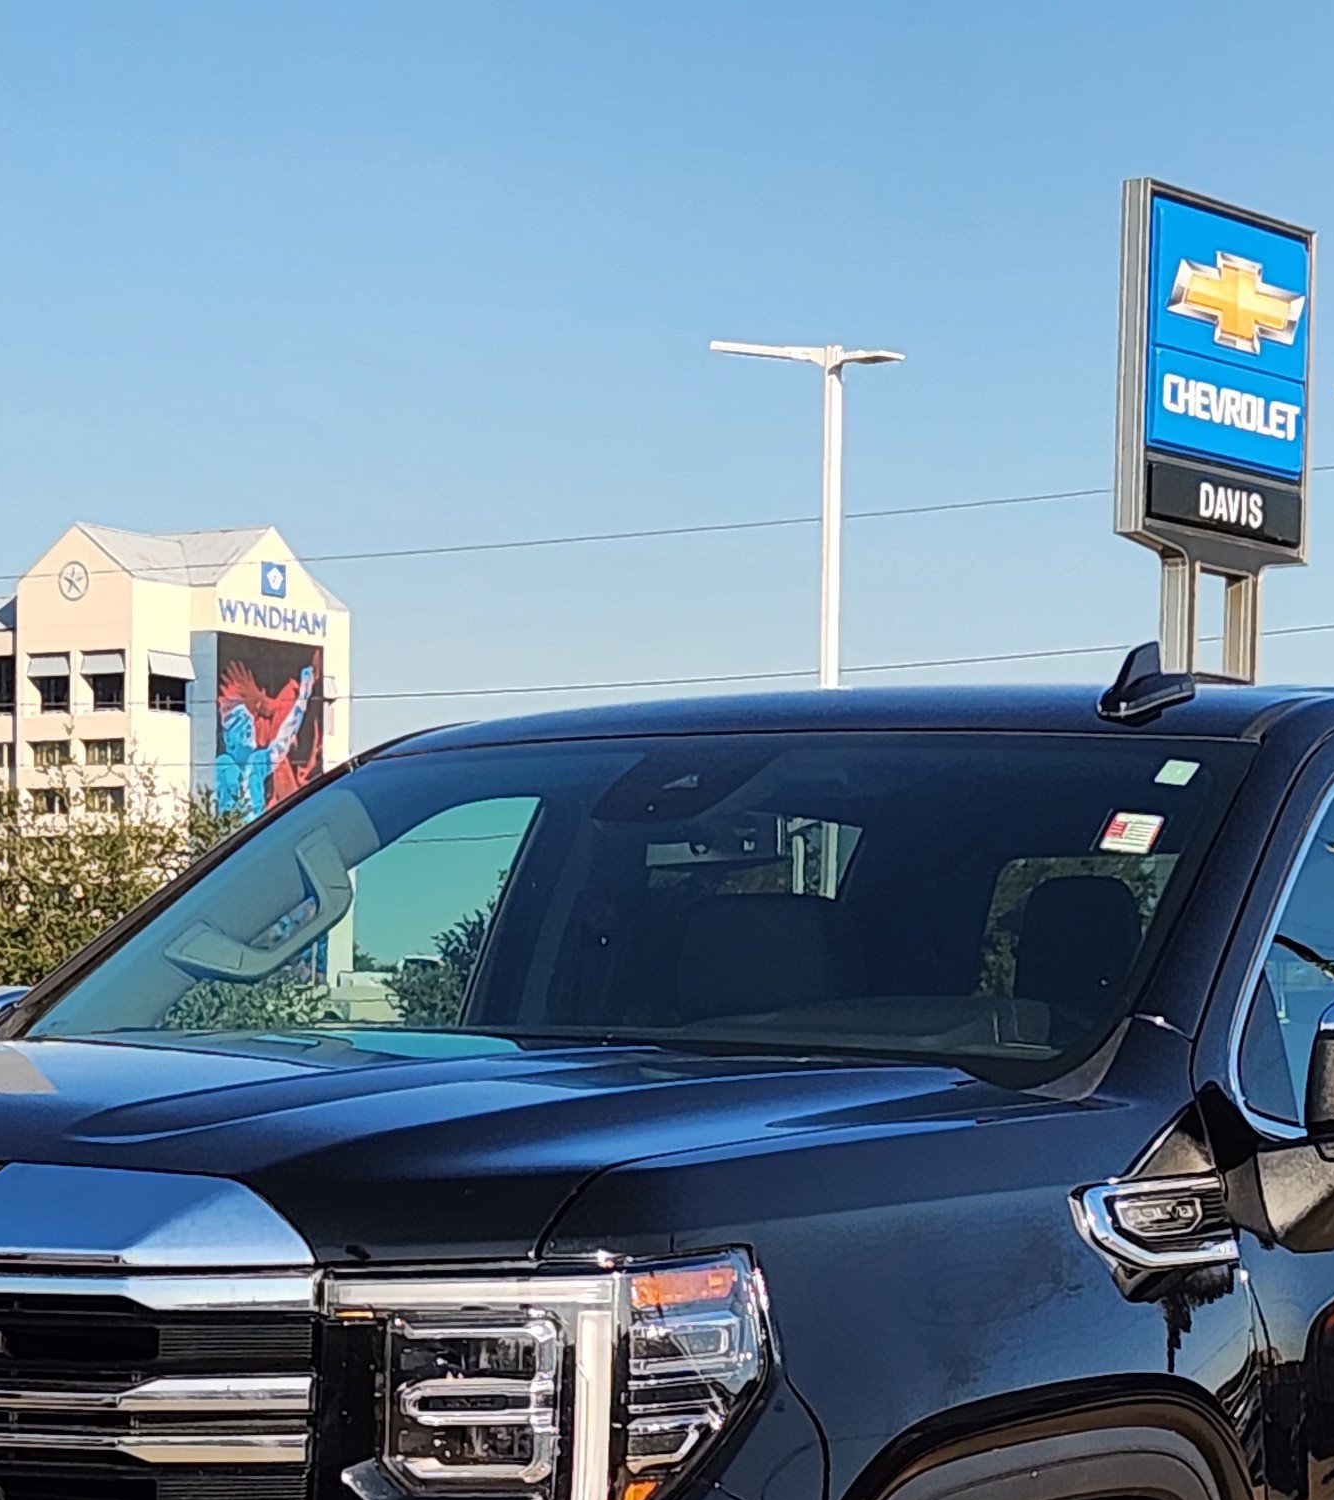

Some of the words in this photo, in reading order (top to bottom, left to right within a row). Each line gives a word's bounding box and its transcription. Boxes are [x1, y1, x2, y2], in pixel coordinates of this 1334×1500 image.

[1163, 372, 1301, 442] CHEVROLET
[1198, 482, 1263, 530] DAVIS
[218, 597, 327, 638] WYNDHAM
